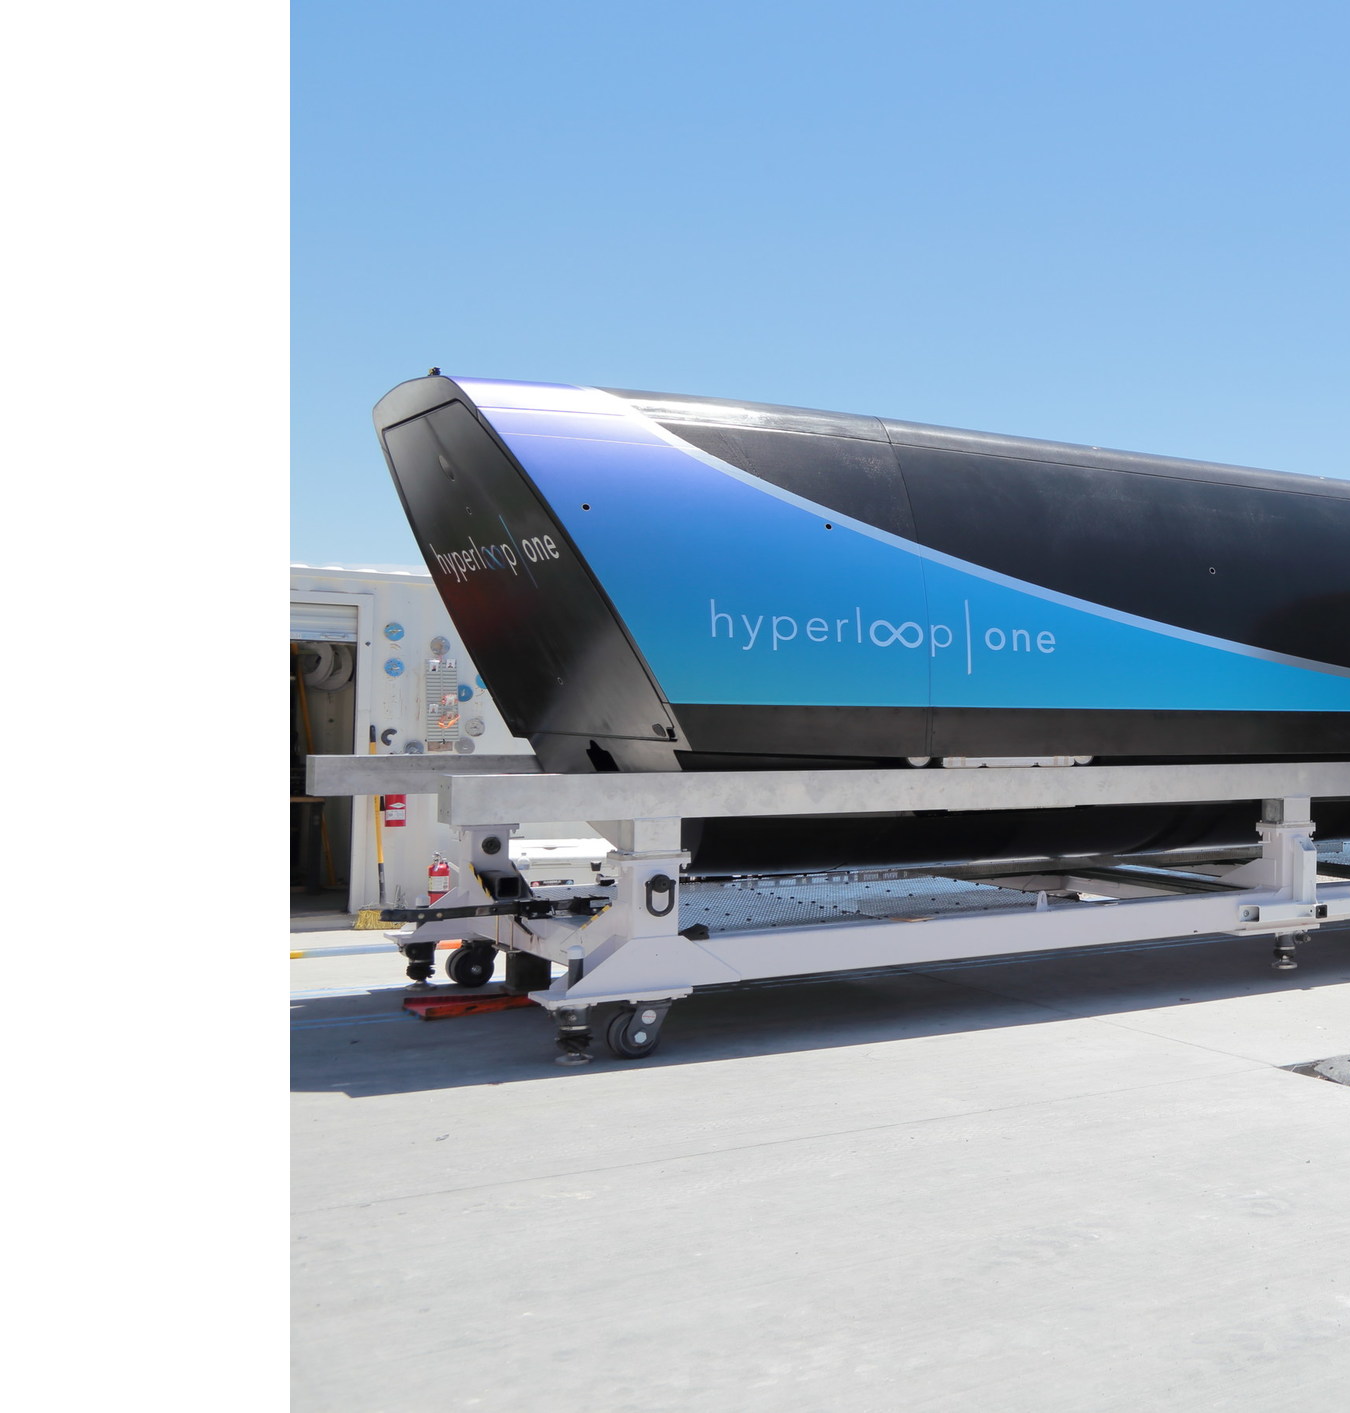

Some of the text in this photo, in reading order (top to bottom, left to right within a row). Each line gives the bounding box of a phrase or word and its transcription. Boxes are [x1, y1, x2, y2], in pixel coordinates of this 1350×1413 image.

[522, 534, 560, 562] one
[710, 599, 1057, 657] hyperloop one
